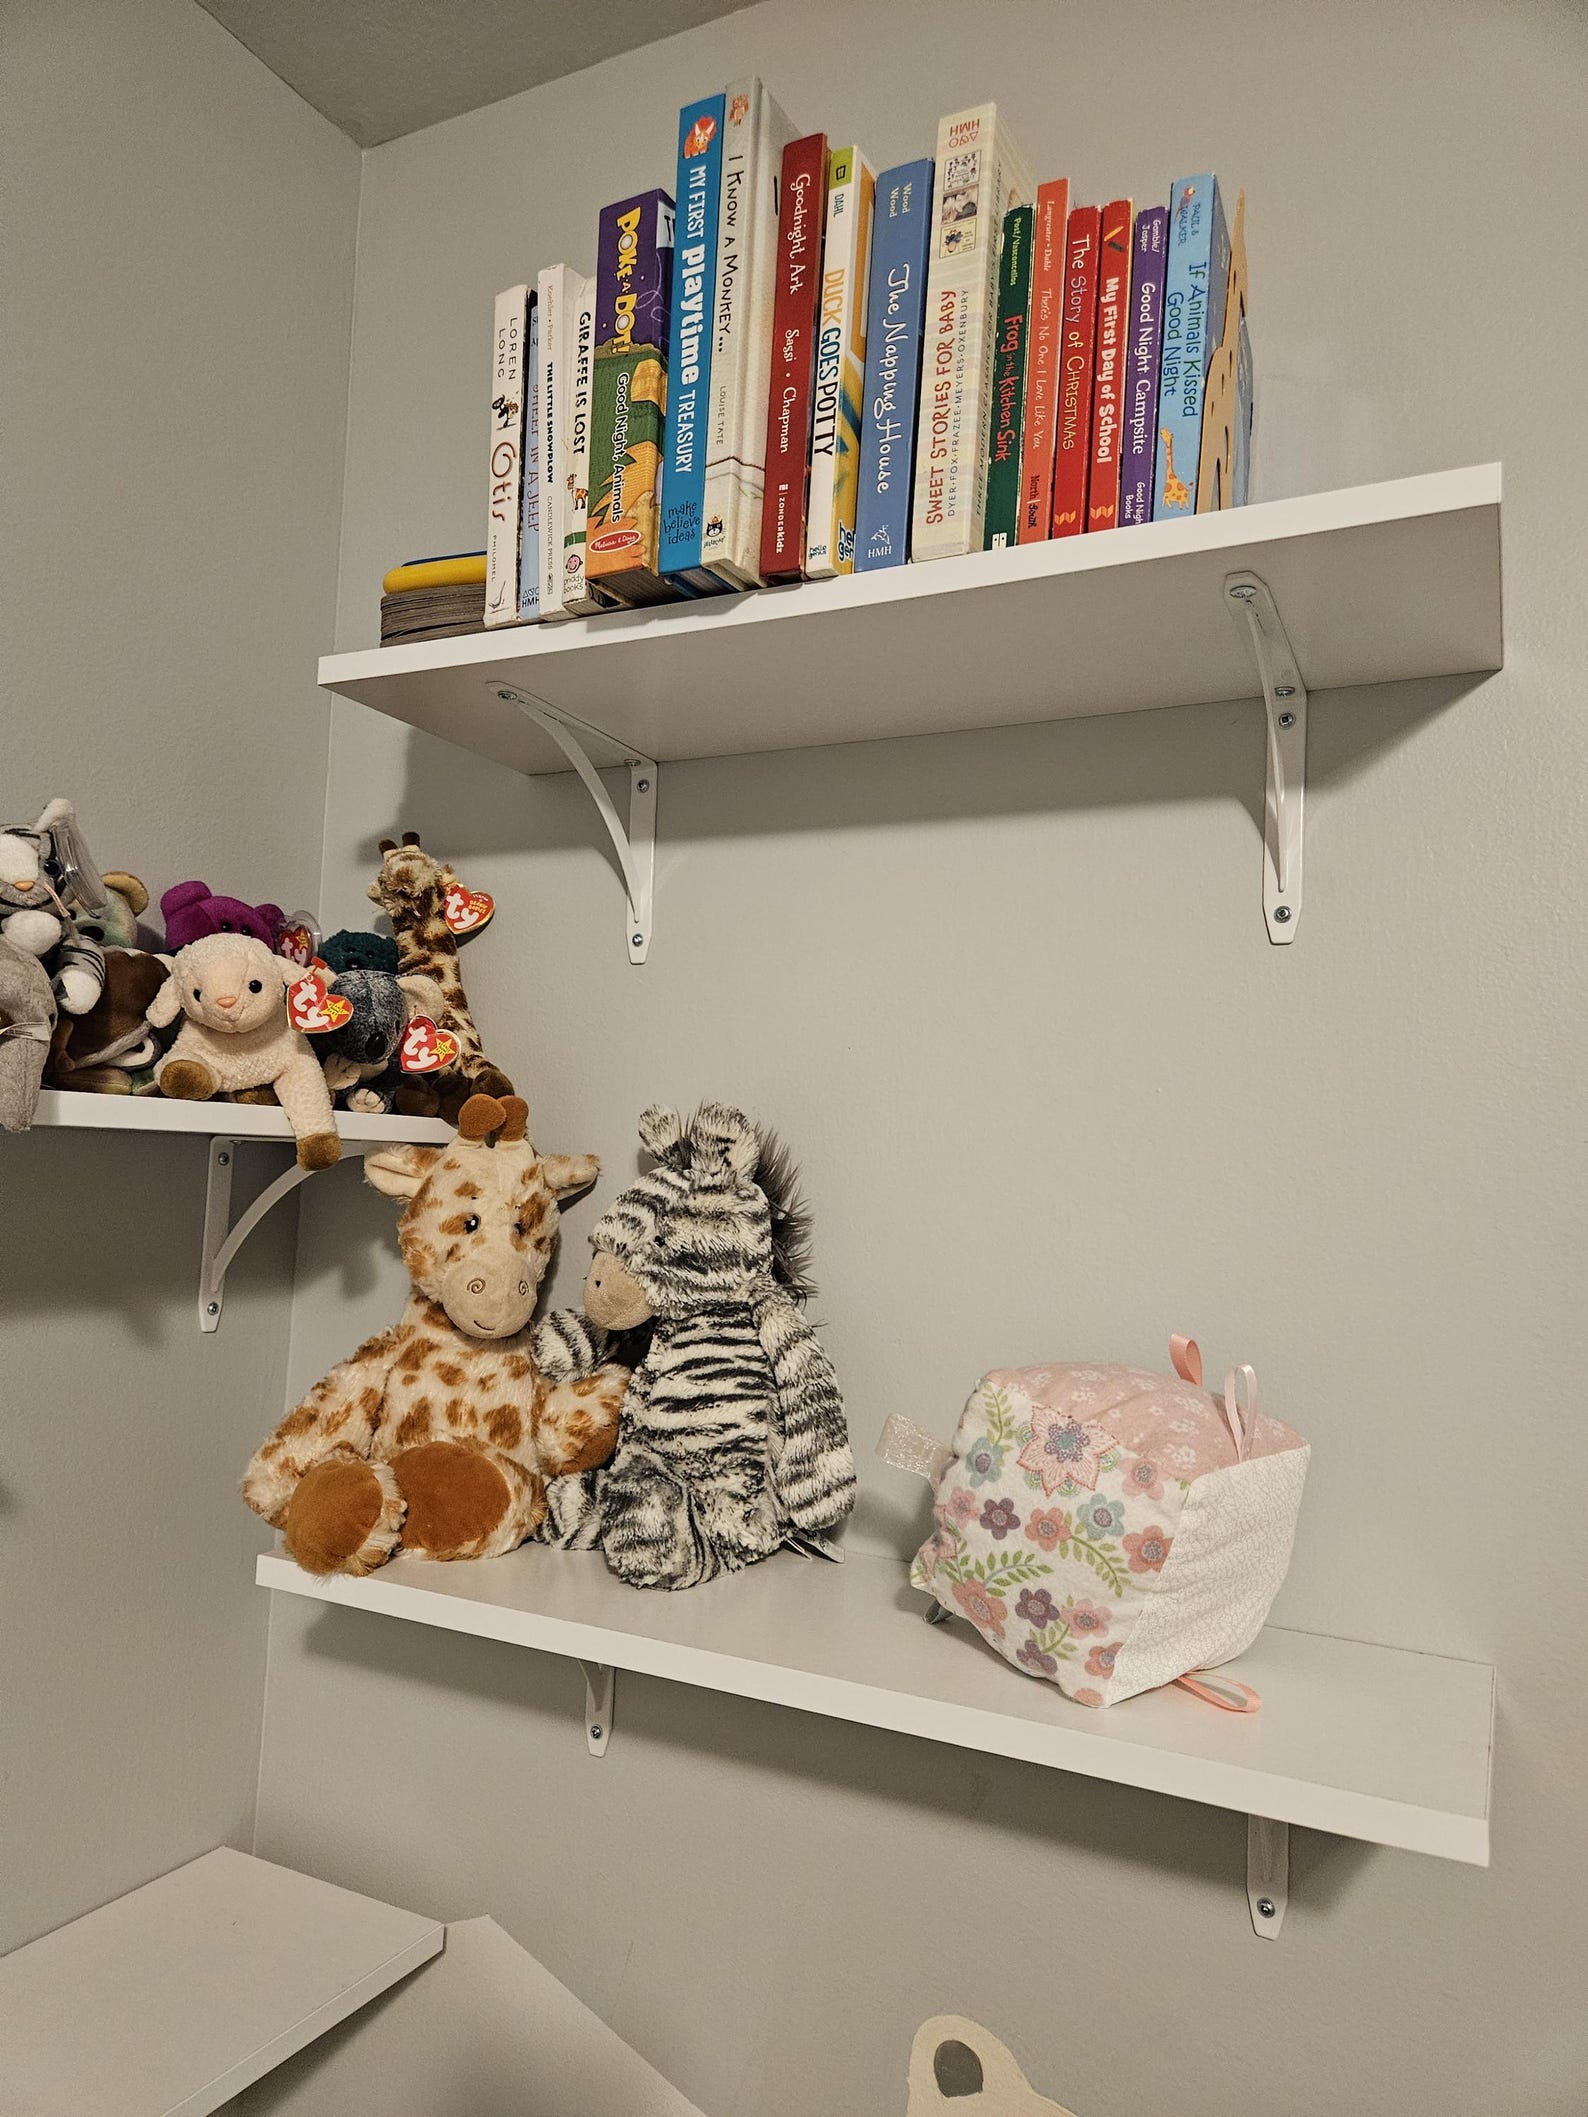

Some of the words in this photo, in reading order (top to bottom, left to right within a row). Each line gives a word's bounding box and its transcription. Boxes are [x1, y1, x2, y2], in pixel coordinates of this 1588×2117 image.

[950, 118, 981, 137] HMH
[689, 165, 707, 189] MY
[687, 191, 706, 239] FIRST
[787, 173, 811, 260] Goodnight
[832, 193, 845, 218] DAHL
[889, 187, 899, 218] Wood
[901, 182, 912, 214] Wood
[1191, 203, 1201, 229] PAUL
[1072, 234, 1090, 270] The
[1140, 224, 1151, 252] Jasper
[1151, 219, 1162, 253] Gamble/
[789, 263, 806, 295] Ark
[887, 263, 910, 315] The
[1100, 277, 1120, 303] My
[1188, 262, 1207, 280] If
[822, 268, 846, 327] DUCK
[938, 290, 957, 335] BABY
[1040, 288, 1052, 321] There's
[1065, 276, 1087, 323] Story
[1140, 282, 1155, 323] Good
[1167, 292, 1184, 341] Good
[957, 290, 969, 353] OXENBURY
[1000, 314, 1024, 353] Frog
[1038, 326, 1050, 341] No
[1102, 304, 1118, 345] First
[1187, 283, 1206, 355] Animals
[508, 317, 518, 380] LOREN
[576, 311, 592, 387] GIRAFFE
[783, 329, 800, 362] Sassi
[819, 327, 842, 381] GOES
[936, 337, 956, 376] FOR
[1037, 345, 1048, 365] One
[1067, 331, 1084, 348] of
[1134, 326, 1153, 373] Night
[873, 318, 909, 420] Napping
[954, 357, 964, 405] MEYERS
[1003, 359, 1015, 377] the
[1097, 348, 1117, 382] Day
[1162, 346, 1183, 398] Night
[575, 391, 588, 408] IS
[616, 372, 629, 414] Good
[717, 386, 727, 417] LOUISE
[1034, 378, 1047, 401] Love
[1062, 355, 1085, 450] CHRISTMAS
[1100, 384, 1117, 401] of
[1182, 359, 1201, 417] Kissed
[573, 413, 587, 455] LOST
[675, 389, 696, 473] TREASURY
[716, 421, 725, 445] TATE
[778, 386, 797, 454] Chapman
[814, 381, 838, 456] POTTY
[930, 380, 952, 459] STORIES
[951, 409, 962, 453] FRAZEE
[1033, 405, 1046, 427] Like
[1096, 402, 1117, 464] School
[1129, 379, 1151, 455] Campsite
[546, 421, 554, 484] SNOWPLOW
[612, 416, 627, 462] Night,
[876, 418, 902, 494] House
[994, 430, 1016, 462] Sink
[1032, 430, 1044, 449] You
[491, 441, 517, 522] Otis
[527, 472, 538, 485] A
[949, 458, 959, 482] FOX
[1029, 474, 1040, 499] North
[527, 490, 539, 532] JEEP
[611, 464, 626, 524] Animals
[668, 501, 698, 518] make
[926, 466, 944, 525] SWEET
[948, 486, 956, 517] DYER
[1125, 494, 1134, 519] Books
[1135, 481, 1146, 504] Good
[663, 516, 701, 534] believe
[1135, 505, 1145, 526] Nigh
[668, 528, 696, 544] ideas
[867, 545, 892, 559] HMH
[447, 892, 480, 930] ty
[281, 937, 307, 968] ty
[293, 982, 330, 1029] ty
[403, 1026, 438, 1070] ty
